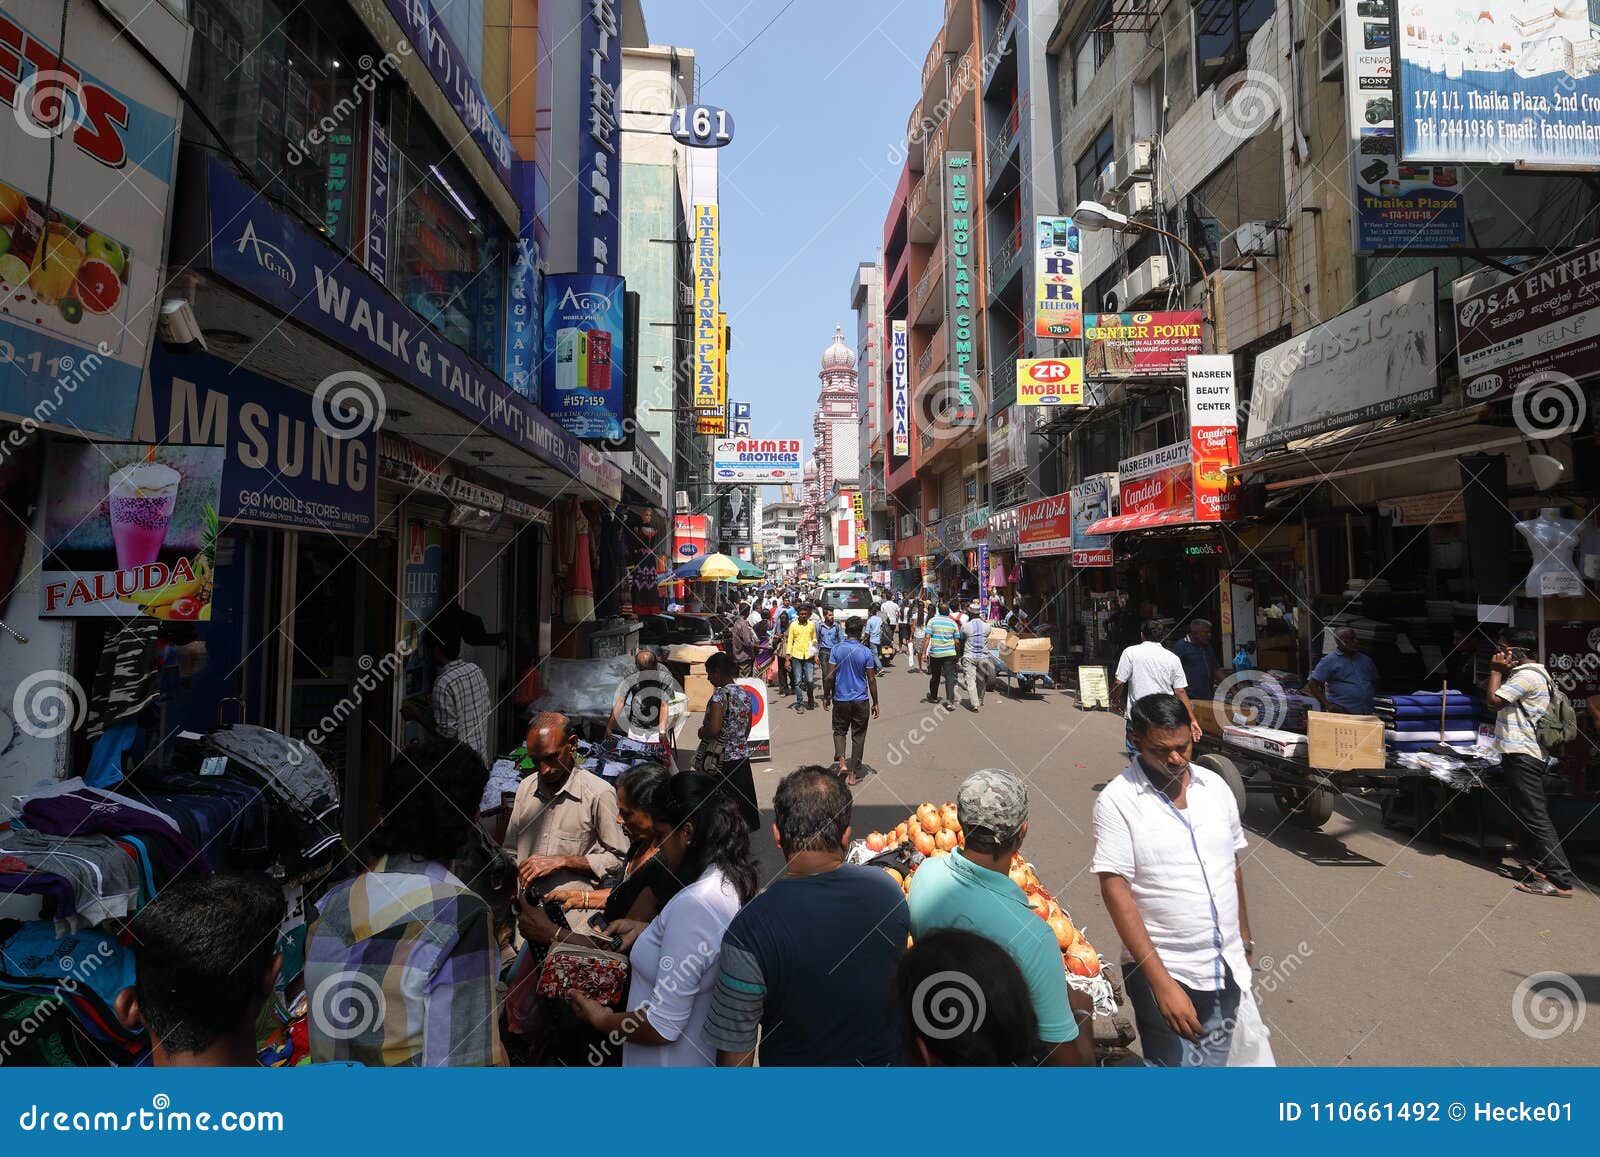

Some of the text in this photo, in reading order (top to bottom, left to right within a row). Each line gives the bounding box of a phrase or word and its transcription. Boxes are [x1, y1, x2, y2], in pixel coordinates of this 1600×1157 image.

[1415, 91, 1437, 110] 174
[1468, 91, 1509, 110] Thaika
[1513, 92, 1550, 113] Plaza,
[1554, 92, 1578, 112] 2nd
[676, 107, 730, 141] 161
[1415, 118, 1436, 137] Tel:
[1441, 119, 1494, 138] 2441936
[1498, 119, 1536, 139] Email:
[952, 175, 969, 213] NEW
[1364, 197, 1457, 208] Thaika Plaza
[953, 218, 970, 309] MOULANA
[1045, 258, 1074, 274] R
[1045, 284, 1074, 300] R
[1487, 286, 1520, 314] S.A
[699, 206, 714, 395] INTERNATIONAL PLAZA
[1040, 302, 1079, 310] TELECOM
[1086, 324, 1200, 340] CENTER POINT
[1538, 317, 1585, 346] KEUNE
[1472, 338, 1524, 360] KRYOLAN
[314, 265, 410, 364] WALK
[416, 341, 432, 378] &
[438, 352, 486, 412] TALK
[526, 416, 565, 459] LIMITED
[956, 314, 972, 406] COMPLEX
[1033, 364, 1066, 378] ZR
[1192, 370, 1232, 378] NASREEN
[894, 333, 906, 434] MOULANA
[1022, 384, 1079, 395] MOBILE
[1495, 377, 1500, 387] B
[564, 396, 604, 406] #157-159
[1197, 402, 1230, 410] CENTER
[1328, 411, 1359, 426] Colombo
[1198, 427, 1232, 440] Candela
[736, 440, 800, 452] AHMED
[1207, 437, 1227, 448] Soap
[740, 453, 798, 462] BROTHERS
[1120, 444, 1190, 475] NASREEN BEAUTY
[1125, 480, 1162, 508] Candela
[1201, 492, 1237, 504] Candela
[263, 495, 304, 514] MOBILE
[305, 502, 340, 519] STORES
[1022, 503, 1046, 532] World
[1046, 498, 1068, 520] Wide
[1210, 502, 1230, 512] Soap
[1078, 553, 1111, 564] ZR MOBILE
[45, 557, 197, 612] FALUDA
